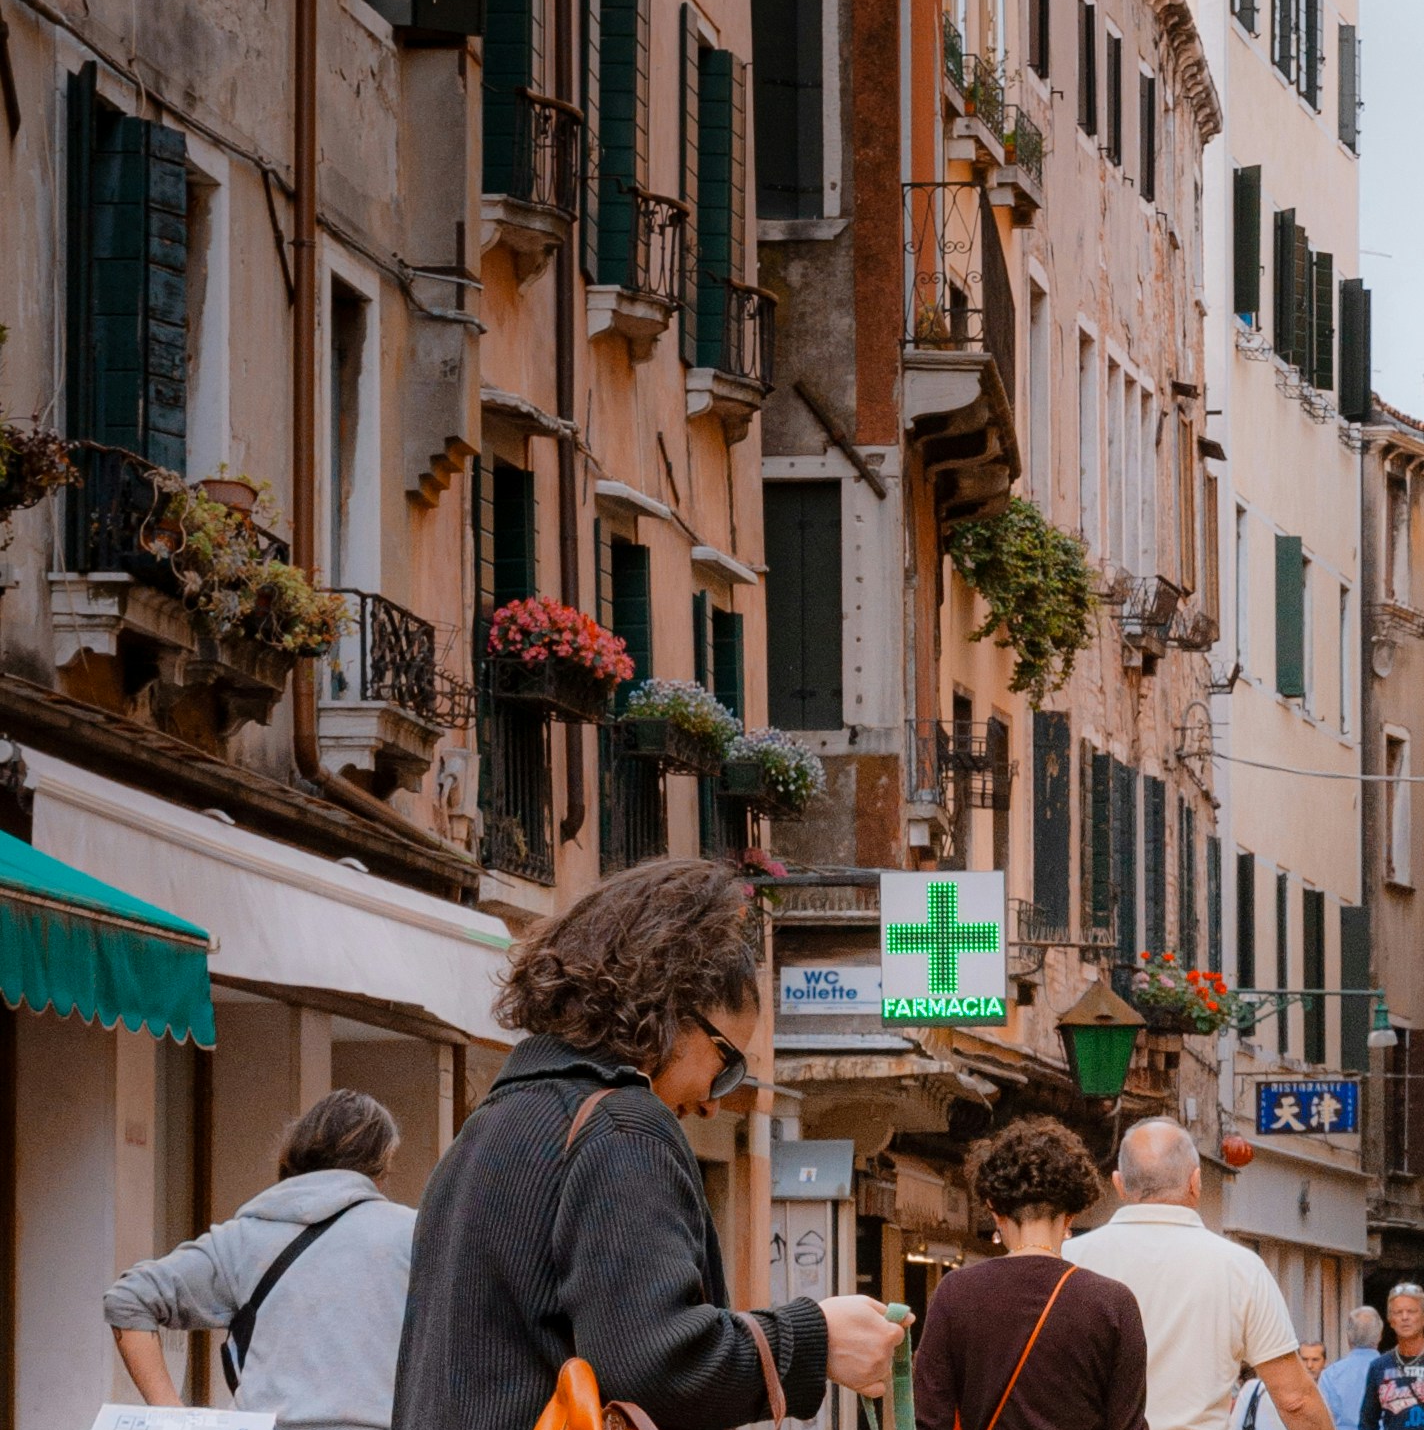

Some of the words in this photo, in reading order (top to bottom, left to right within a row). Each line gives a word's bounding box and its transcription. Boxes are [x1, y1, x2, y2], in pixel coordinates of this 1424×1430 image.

[803, 970, 840, 986] WC
[785, 985, 858, 1000] toilette
[883, 996, 1004, 1018] FARMACIA
[1269, 1092, 1342, 1133] 天津
